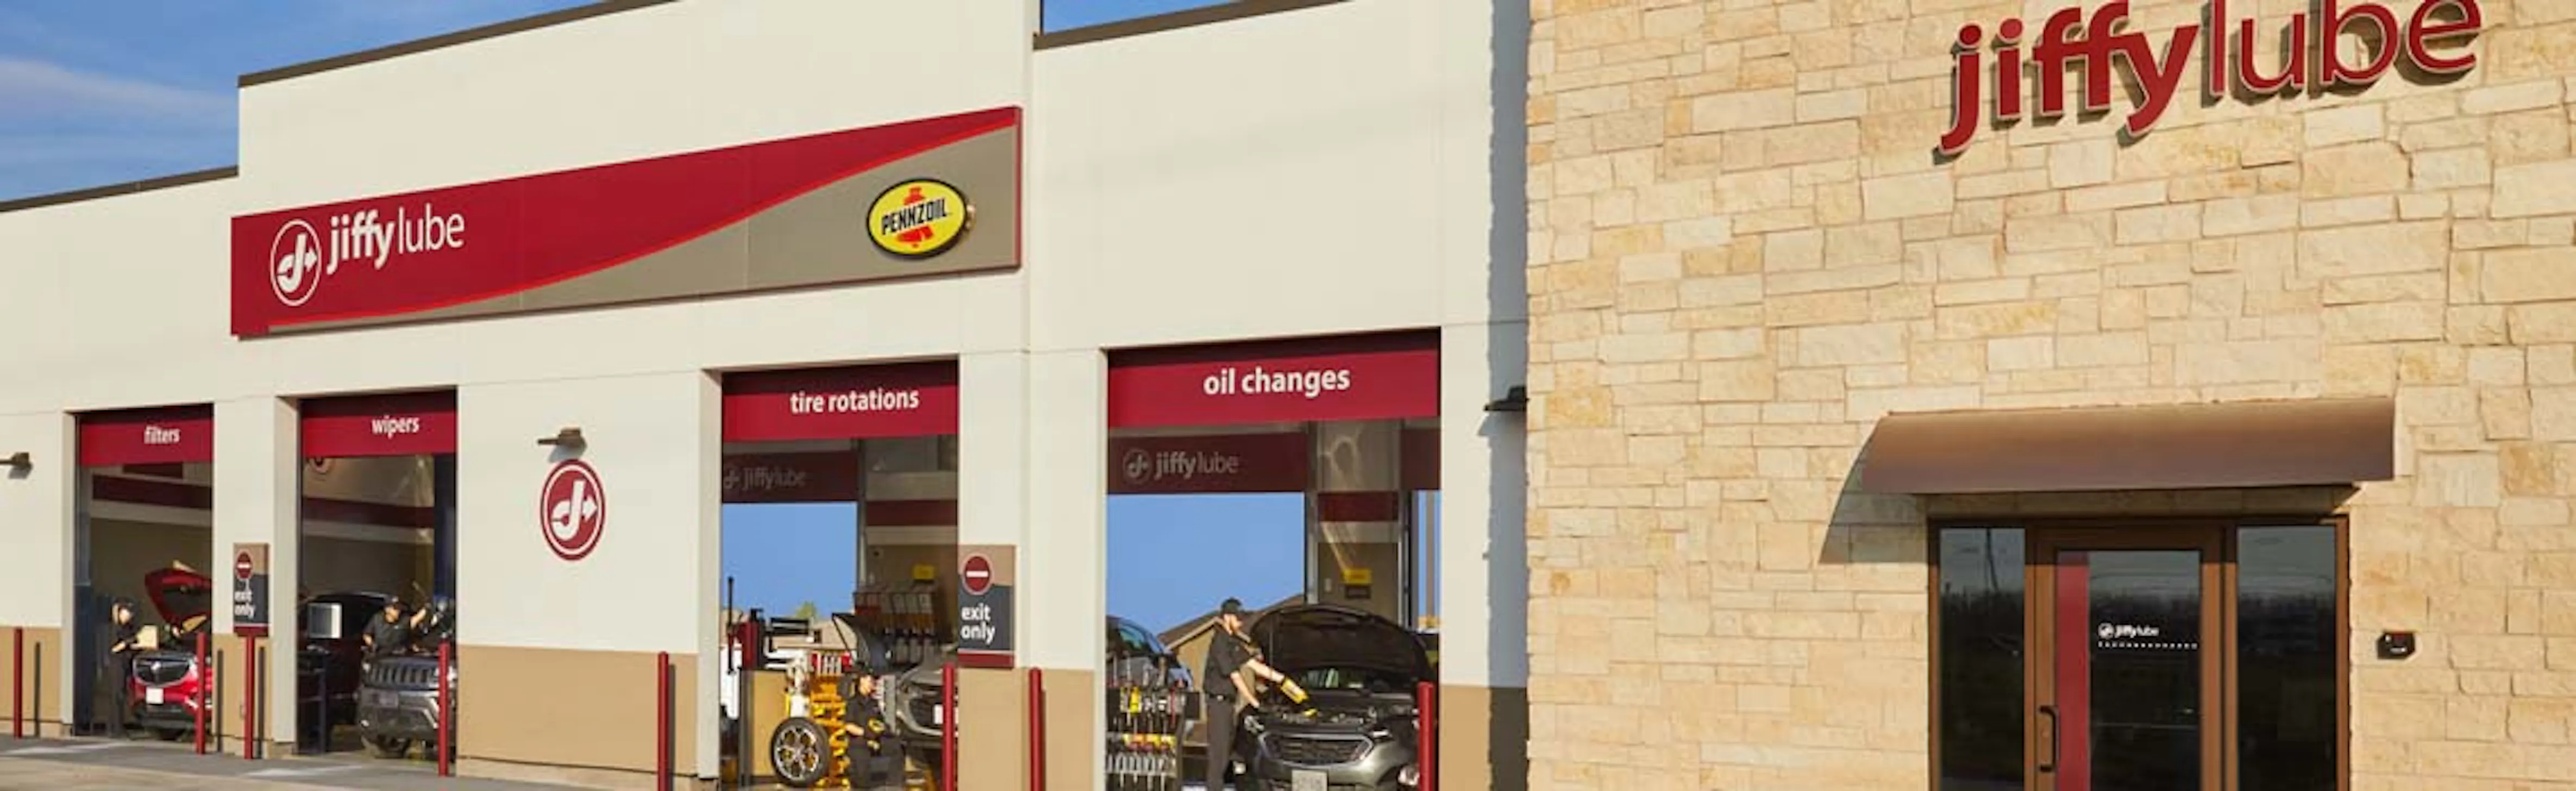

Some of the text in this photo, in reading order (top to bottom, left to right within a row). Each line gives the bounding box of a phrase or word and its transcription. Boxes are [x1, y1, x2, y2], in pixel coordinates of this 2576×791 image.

[1203, 366, 1351, 399] oil changes
[790, 386, 919, 413] tire rotations
[143, 424, 180, 444] filters
[372, 415, 420, 440] wipers
[234, 588, 252, 602] exit
[234, 602, 256, 619] only
[961, 602, 991, 622] exit
[961, 621, 995, 645] only
